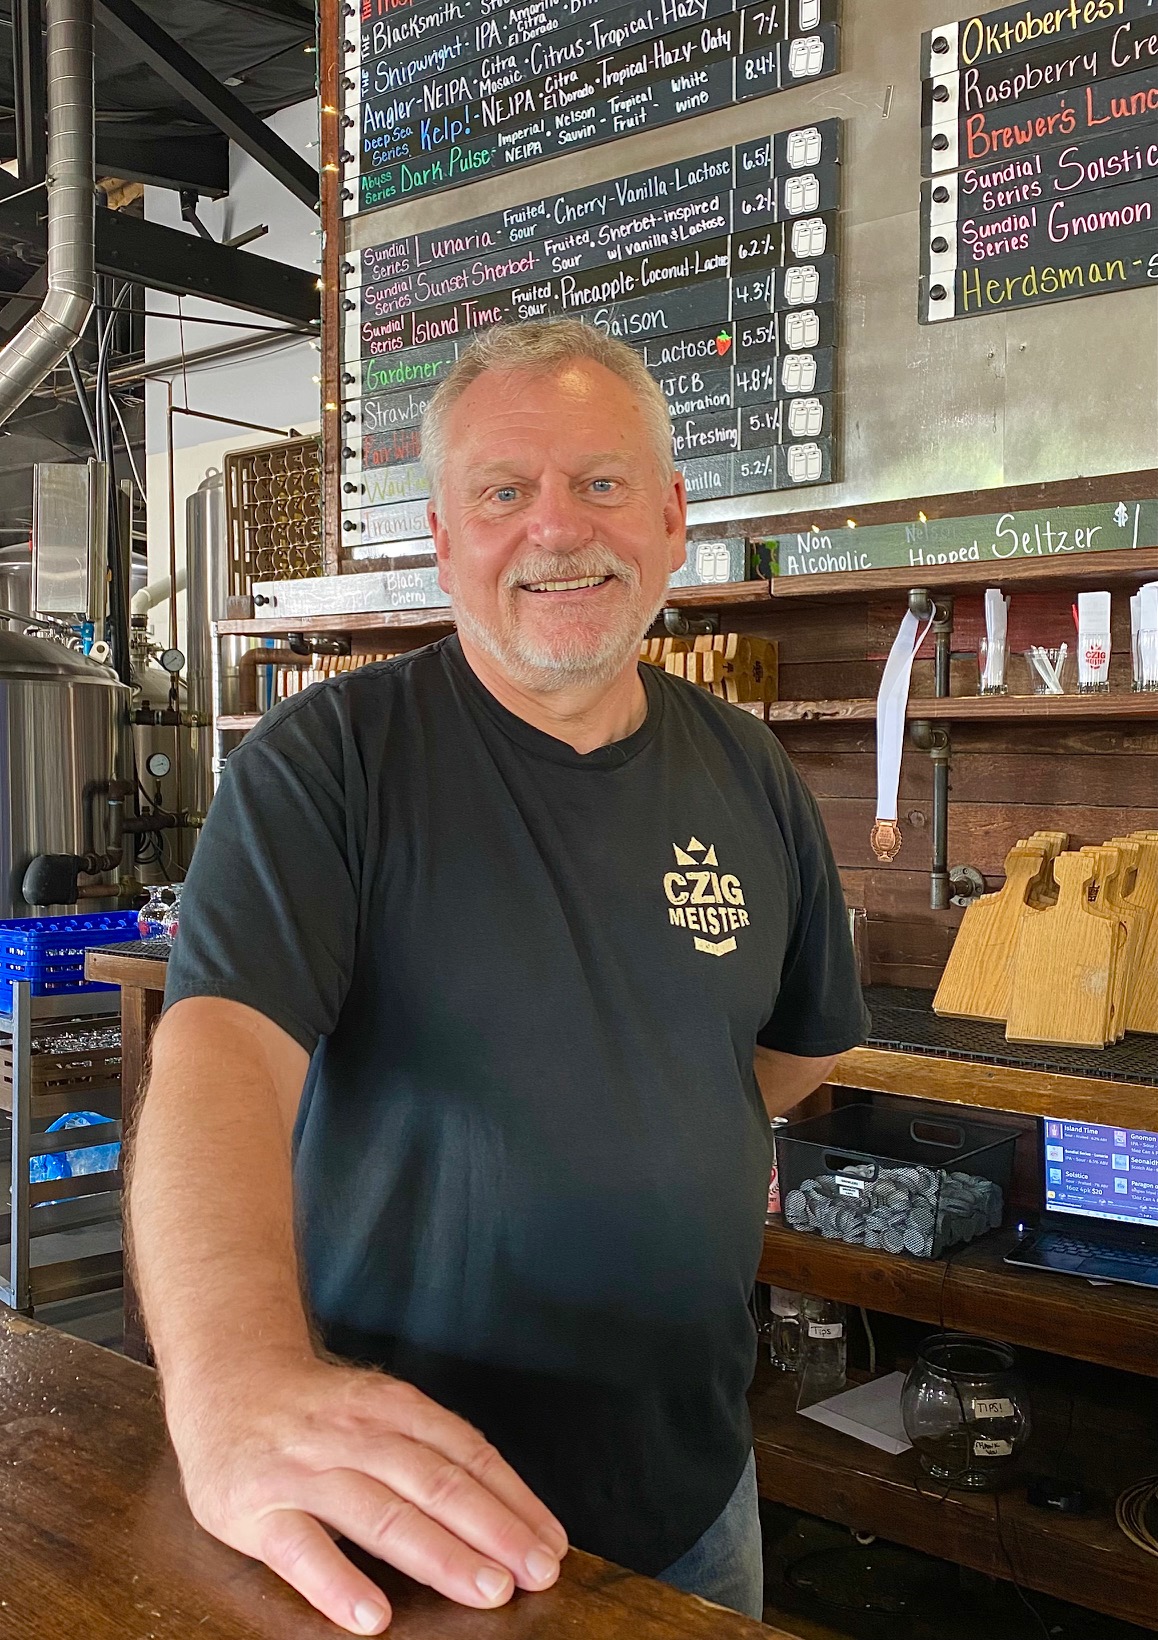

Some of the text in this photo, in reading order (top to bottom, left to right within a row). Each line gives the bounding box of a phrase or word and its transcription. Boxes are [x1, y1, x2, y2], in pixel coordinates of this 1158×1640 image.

[373, 3, 465, 54] Blacksmith
[476, 19, 502, 51] IPA
[517, 13, 547, 32] Citra
[523, 19, 559, 42] Dorado
[481, 56, 517, 78] Citra
[965, 52, 1097, 111] Raspberry
[479, 70, 523, 98] Mosaic
[545, 71, 578, 93] Citra
[559, 83, 595, 107] Dorado
[481, 90, 536, 127] NEIPA
[498, 119, 544, 147] Imperial
[555, 106, 596, 129] Nelson
[607, 87, 652, 115] Tropical
[744, 52, 775, 80] 8.4%
[505, 141, 542, 162] NEIPA
[558, 124, 596, 145] Sauvin
[614, 107, 647, 132] Fruit
[362, 147, 491, 192] Abyss Dark Pulse
[962, 155, 1042, 194] Sundial
[503, 200, 546, 228] Fruited
[962, 201, 1151, 245] Sundial Gnomon
[363, 231, 495, 267] Sundial Lunaria
[544, 230, 590, 256] Fruited
[364, 276, 413, 304] Sundial
[415, 270, 469, 301] Sunset
[511, 282, 552, 306] Fruited
[962, 258, 1127, 311] Herdsman
[361, 300, 503, 346] Sundial Island Time
[593, 308, 669, 338] Saison
[364, 394, 428, 430] Strawbe
[643, 338, 718, 367] Lactose
[736, 364, 774, 393] 4.8%
[668, 393, 731, 417] aboration
[788, 552, 872, 575] Alcoholic
[992, 514, 1102, 558] Seltzer
[797, 533, 832, 553] Non
[1085, 651, 1106, 659] CZIG
[663, 871, 745, 905] CZIG
[668, 907, 751, 935] MEISTER
[1064, 1125, 1099, 1135] Island Time
[1130, 1133, 1157, 1142] Gnomon
[1065, 1171, 1089, 1179] Solstice
[811, 1326, 831, 1337] Tips
